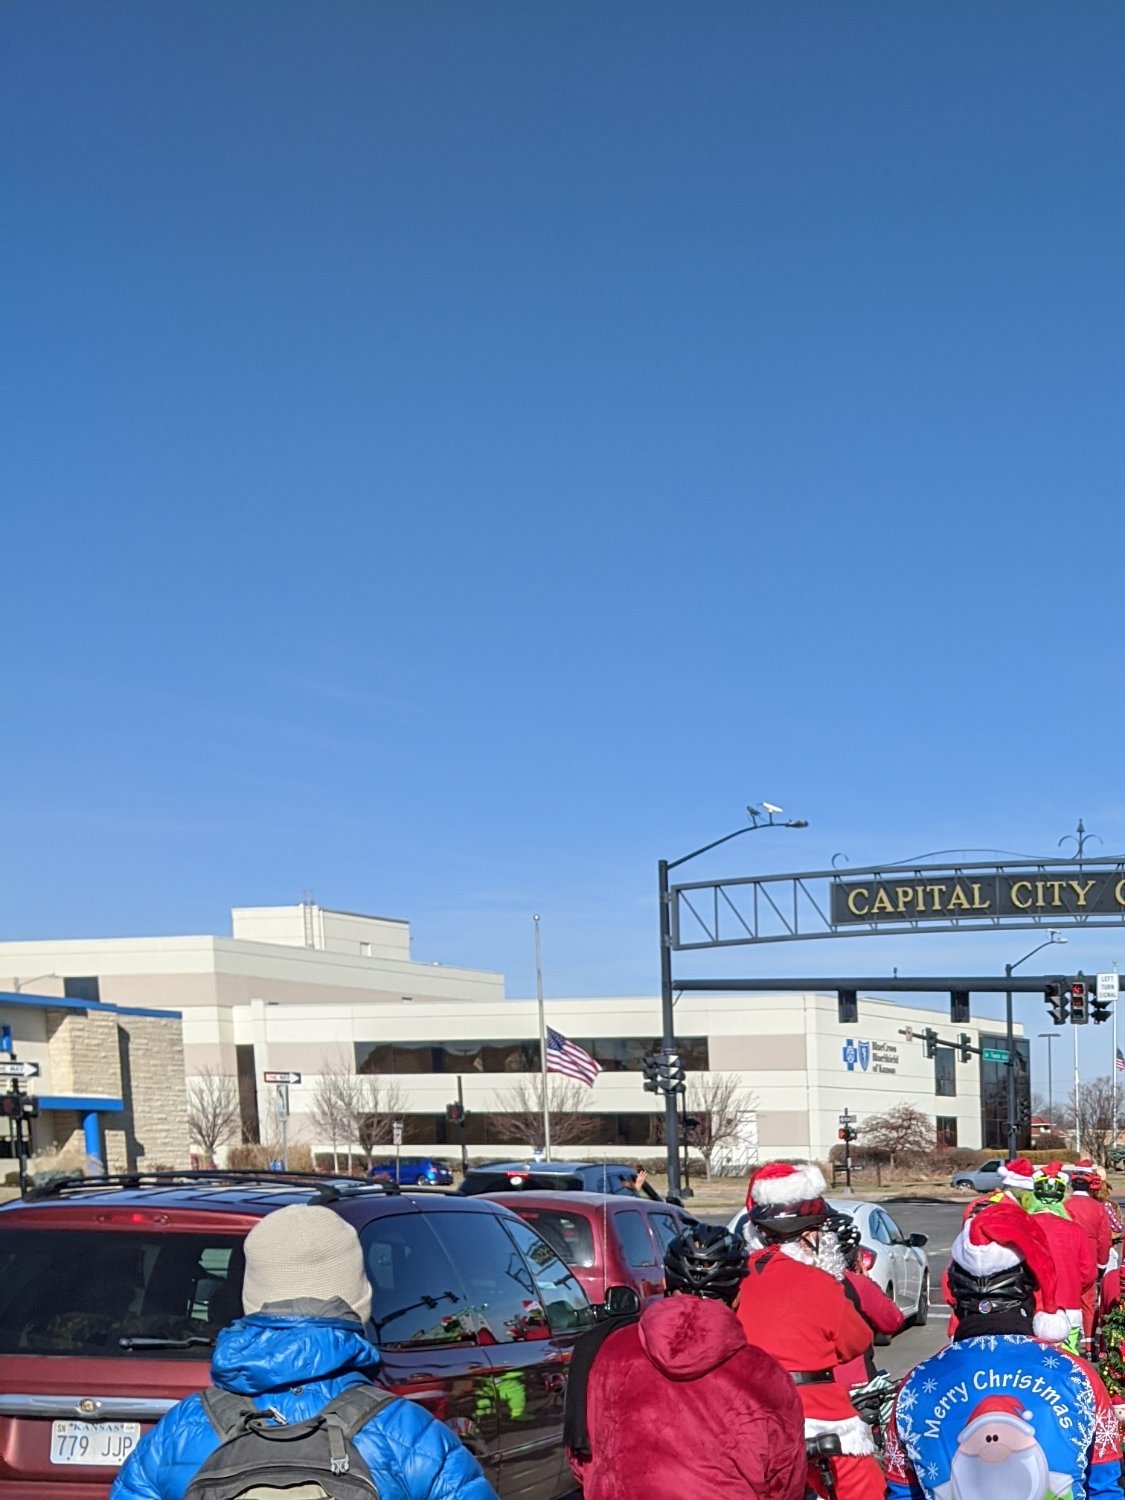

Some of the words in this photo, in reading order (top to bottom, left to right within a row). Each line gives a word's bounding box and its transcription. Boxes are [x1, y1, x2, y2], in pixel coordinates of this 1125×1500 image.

[847, 883, 991, 915] CAPITAL
[1010, 880, 1096, 909] CITY
[923, 1382, 969, 1439] Merry
[973, 1369, 1073, 1430] Christmas
[57, 1436, 89, 1457] 779
[101, 1436, 133, 1457] JJP
